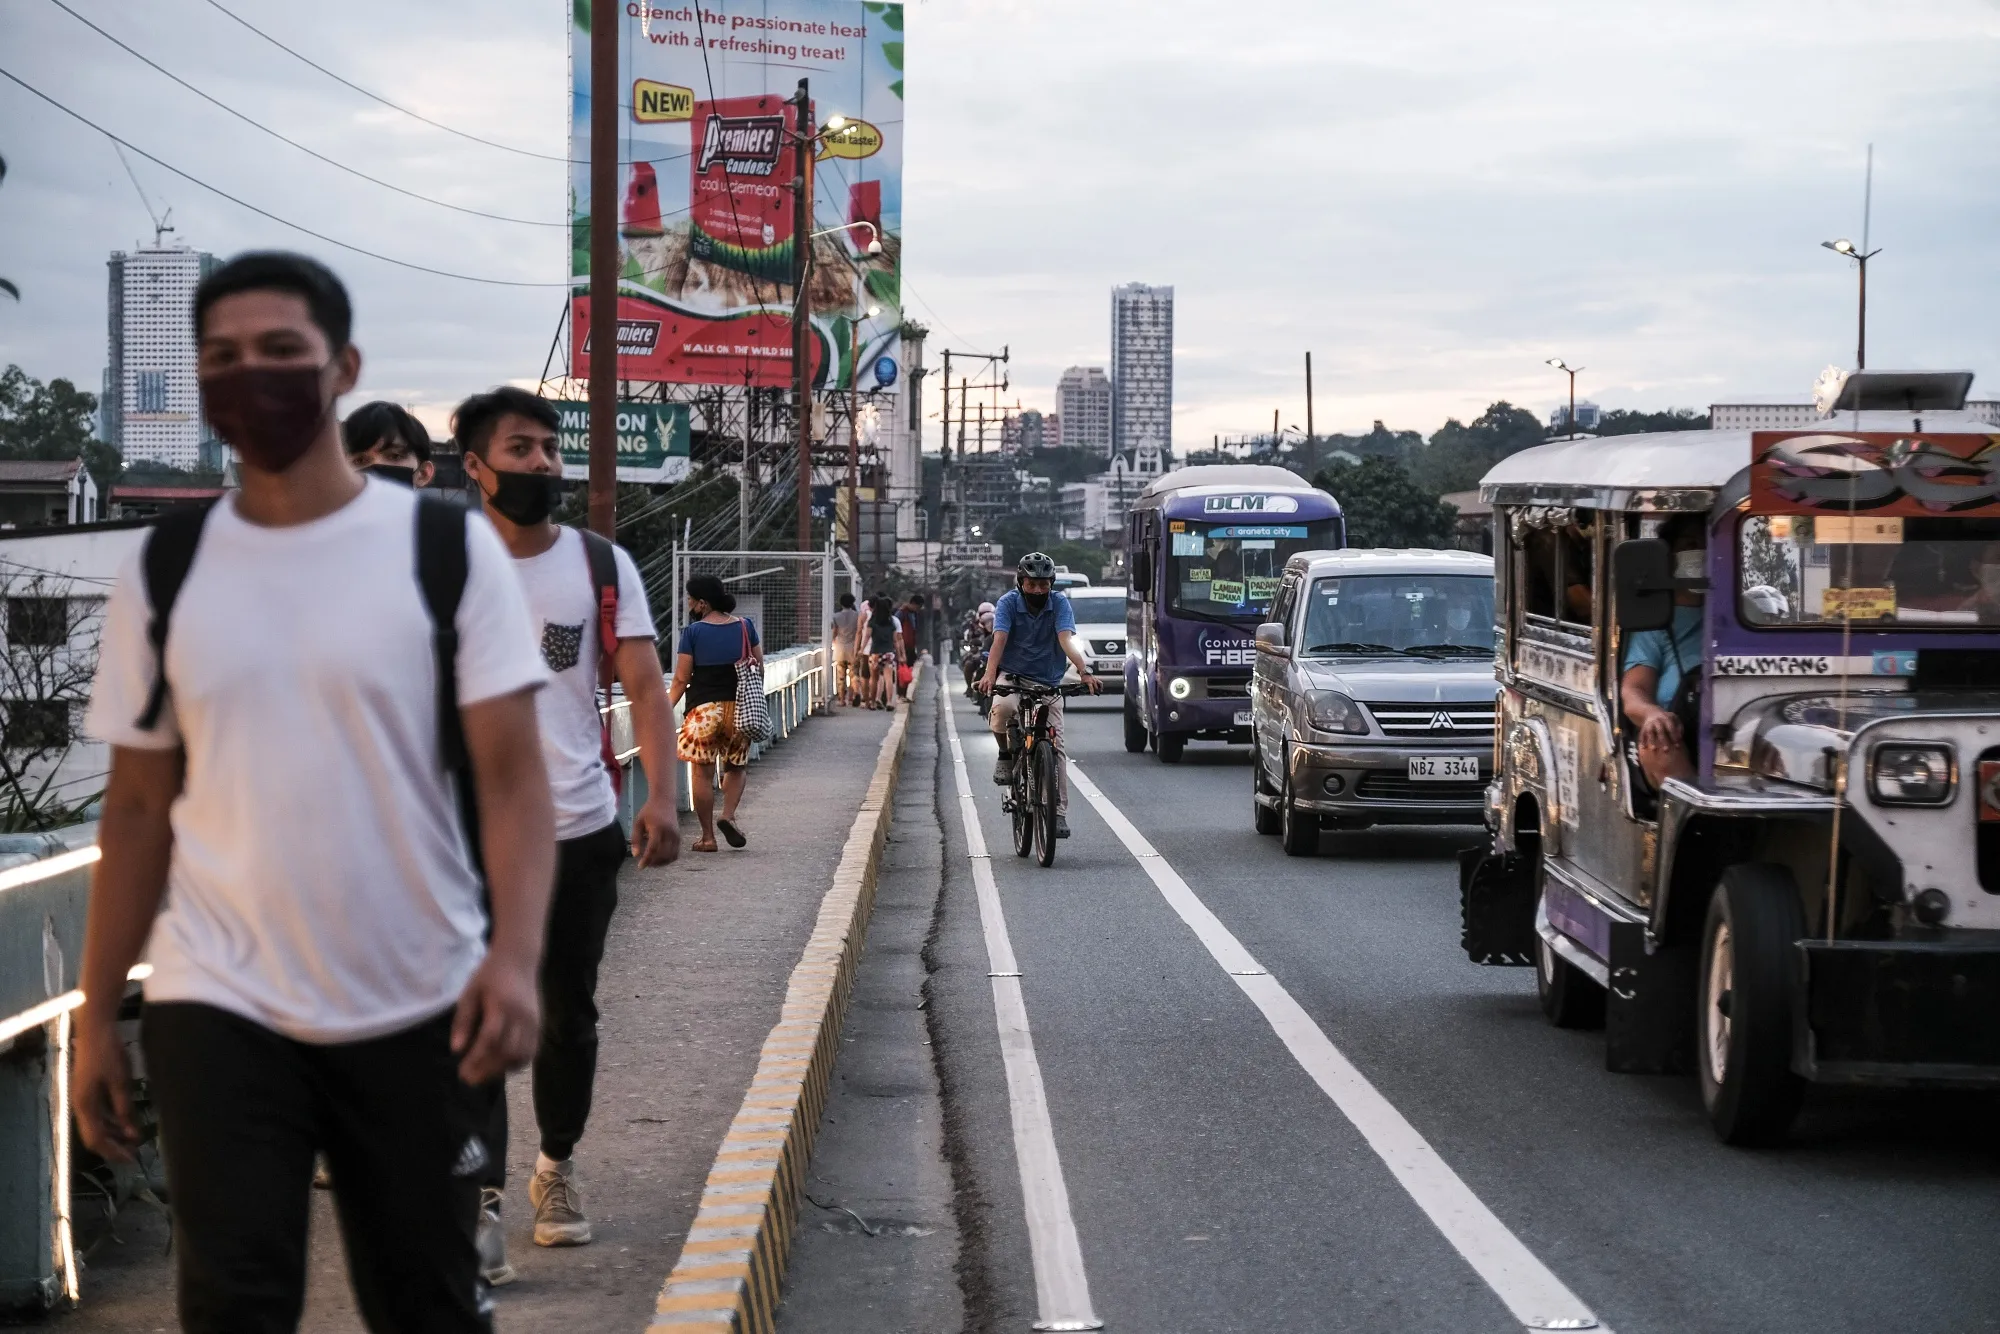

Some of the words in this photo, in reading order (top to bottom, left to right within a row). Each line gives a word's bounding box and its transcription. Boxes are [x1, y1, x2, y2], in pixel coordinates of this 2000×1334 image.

[626, 2, 693, 22] Quench
[698, 8, 726, 25] the
[731, 15, 826, 35] passionate
[830, 21, 867, 38] heat
[649, 30, 689, 46] with
[693, 36, 703, 48] a
[708, 35, 797, 60] refreshing
[801, 45, 845, 60] treat!
[641, 89, 690, 113] NEW!
[700, 119, 775, 168] Premiere
[700, 179, 720, 190] cool
[683, 343, 714, 353] WALK
[716, 345, 729, 353] ON
[734, 345, 748, 354] THE
[751, 346, 777, 356] WILD
[1206, 496, 1265, 511] DCM
[1237, 527, 1271, 536] araneta
[1273, 526, 1291, 537] city
[1411, 762, 1435, 775] NBZ
[1444, 762, 1477, 775] 3344
